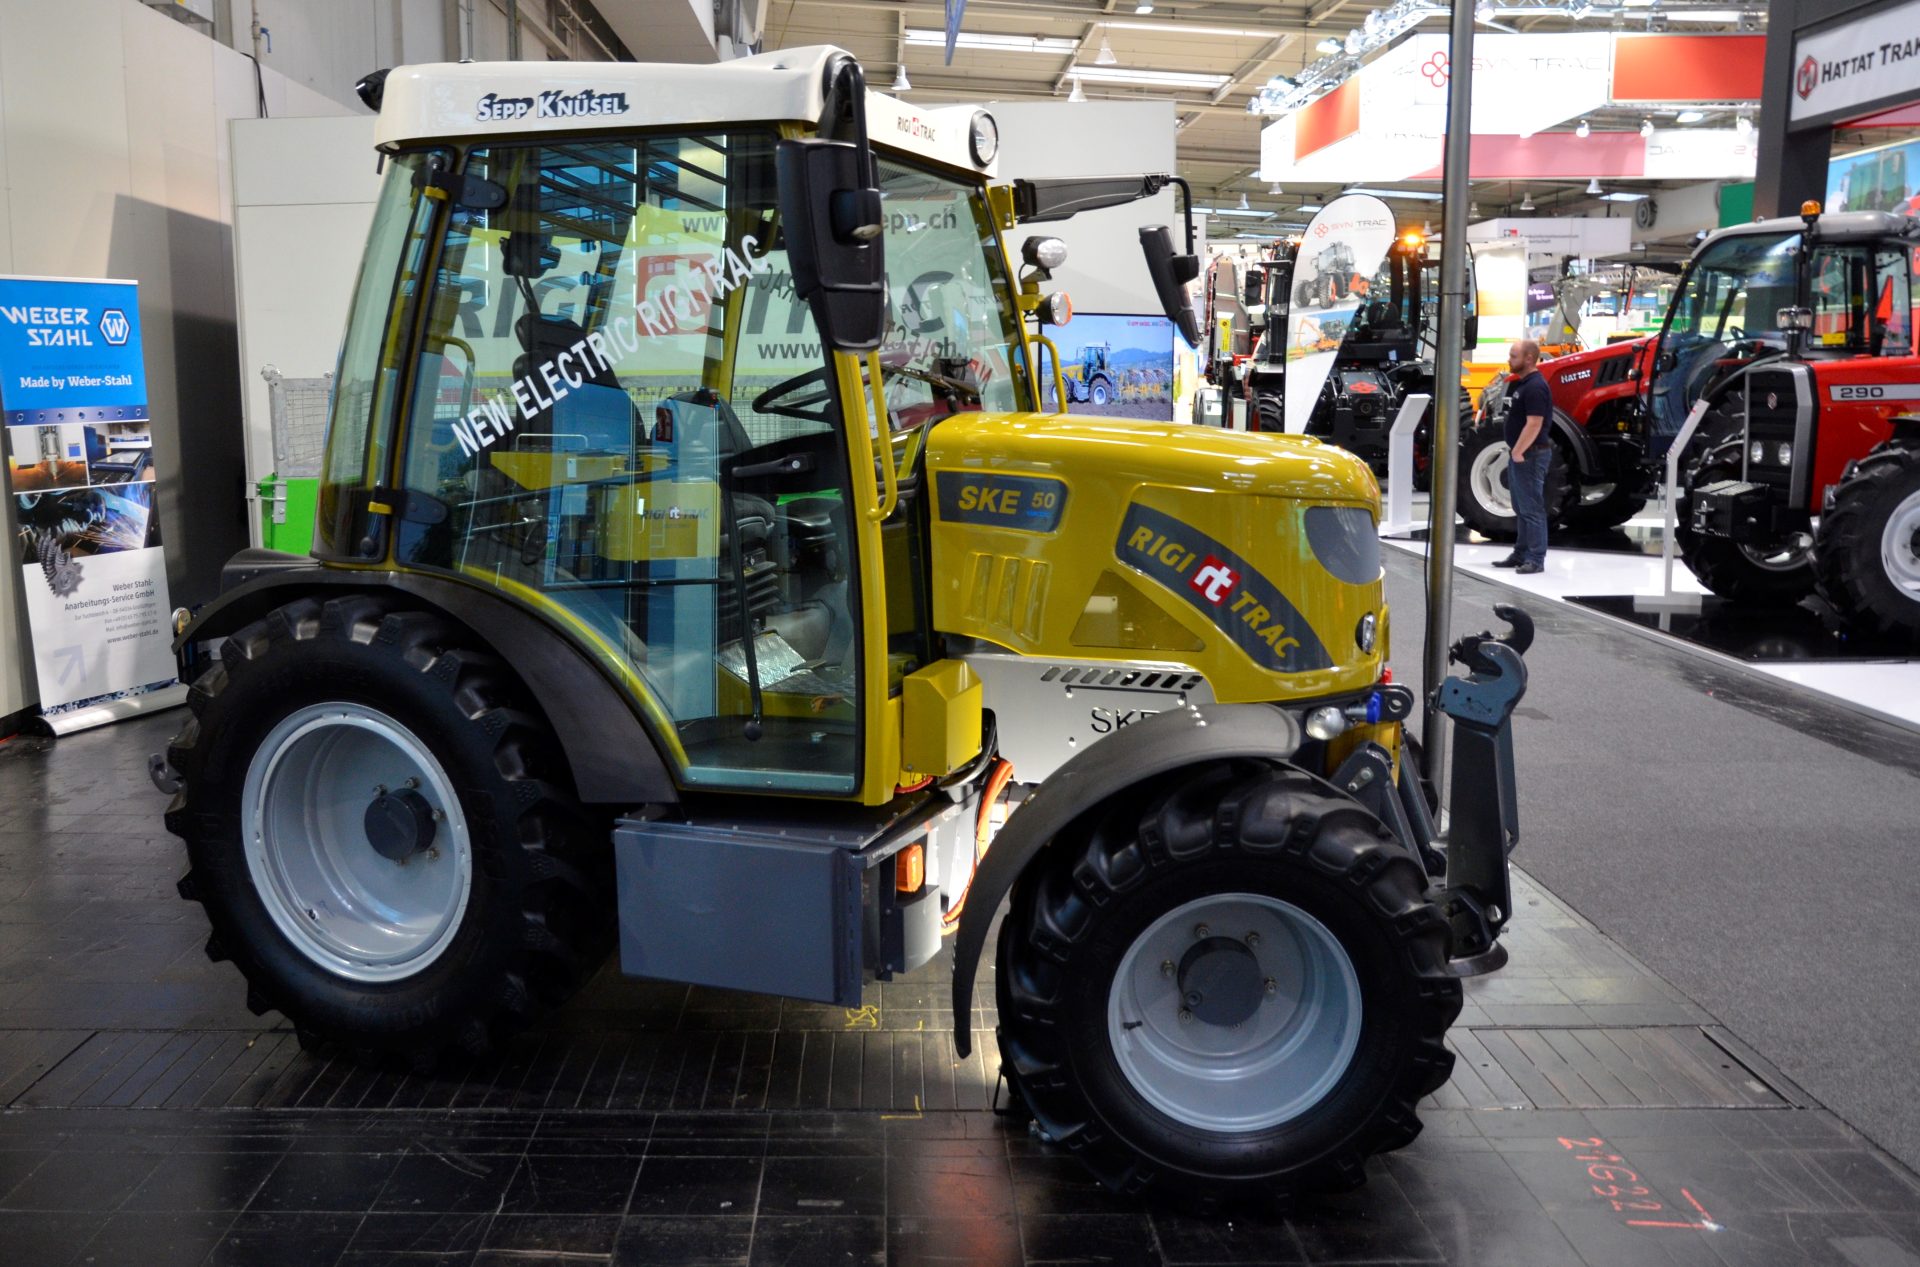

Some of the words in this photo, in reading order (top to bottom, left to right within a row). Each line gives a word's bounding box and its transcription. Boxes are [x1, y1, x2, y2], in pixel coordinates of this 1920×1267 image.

[1821, 51, 1875, 84] HATTAT
[1, 306, 90, 325] WEBER
[28, 328, 93, 346] STAHL
[451, 394, 515, 458] NEW
[510, 316, 639, 421] ELECTRIC
[636, 234, 770, 339] RIGITRAC
[20, 376, 50, 388] Made
[51, 376, 65, 390] by
[67, 374, 133, 387] Weber-Stahl
[1561, 369, 1592, 384] HATTAT
[1840, 386, 1884, 398] 290
[958, 486, 1021, 515] SKE
[1031, 492, 1056, 509] 50
[112, 582, 134, 592] Weber
[134, 589, 155, 599] GmbH
[1127, 525, 1196, 573] RIGI
[1230, 590, 1300, 658] TRAC
